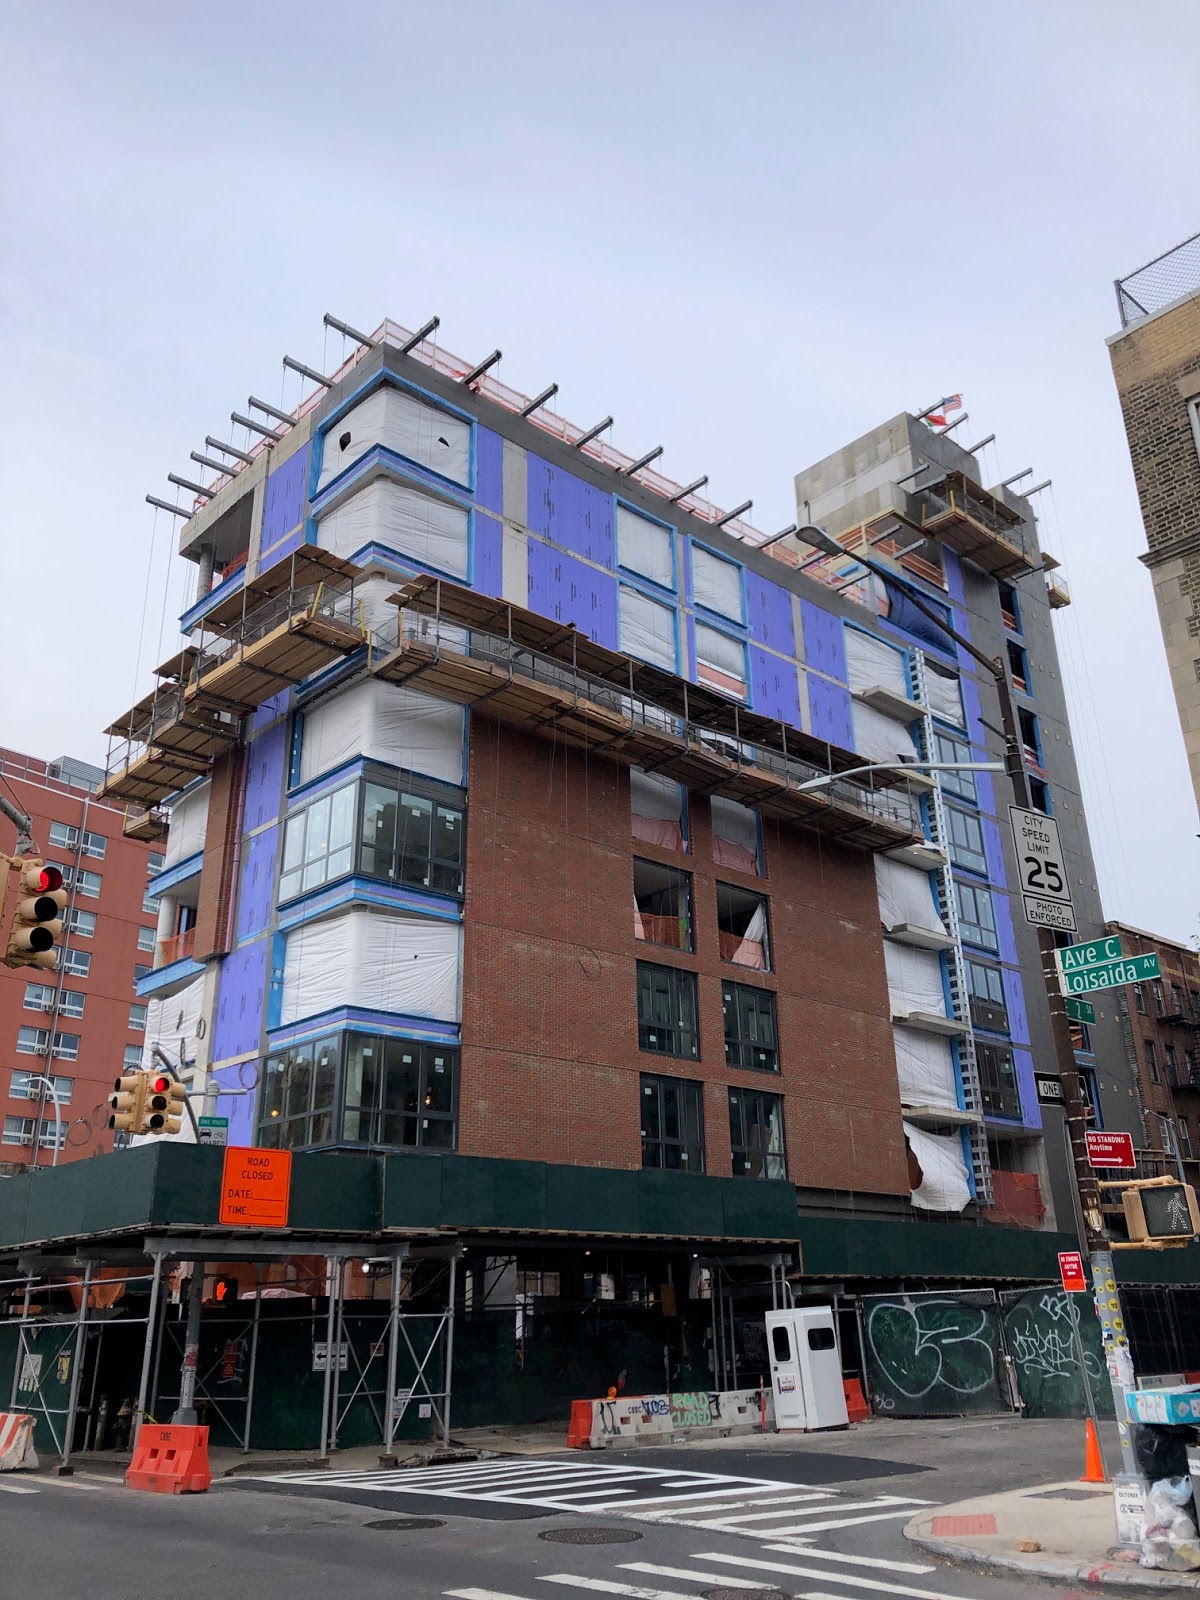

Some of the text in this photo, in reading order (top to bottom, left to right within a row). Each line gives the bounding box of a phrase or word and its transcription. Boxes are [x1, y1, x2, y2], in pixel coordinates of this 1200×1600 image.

[1024, 815, 1043, 829] CITY
[1022, 828, 1051, 843] SPEED
[1027, 842, 1050, 856] LIMIT
[1024, 856, 1063, 893] 25
[1036, 902, 1063, 915] PHOTO
[1030, 910, 1072, 927] ENFORCED
[1065, 939, 1118, 968] Ave C
[1066, 957, 1155, 993] Loisaida Av
[1043, 1082, 1059, 1096] ONE
[1087, 1135, 1126, 1144] NO STANDING
[1089, 1144, 1113, 1153] Anytime
[247, 1157, 270, 1167] ROAD
[241, 1170, 274, 1181] CLOSED
[672, 1392, 709, 1410] ROAD
[670, 1409, 712, 1427] CLOSED
